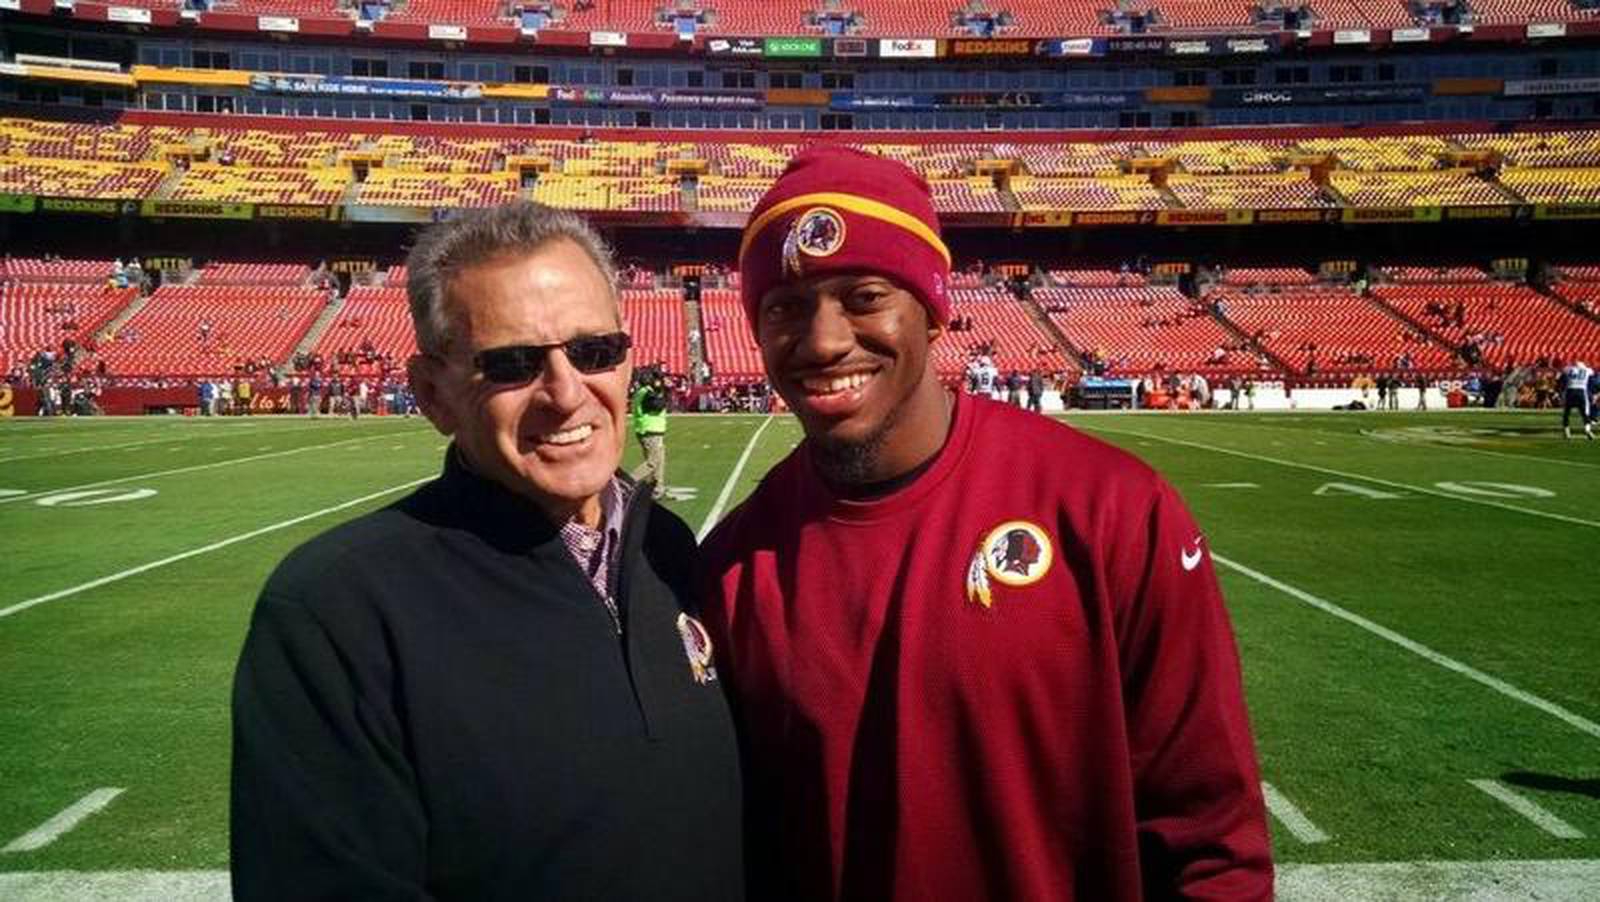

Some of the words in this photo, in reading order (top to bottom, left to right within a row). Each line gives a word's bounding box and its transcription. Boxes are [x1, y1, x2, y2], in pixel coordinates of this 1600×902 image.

[892, 41, 923, 52] FedEx
[954, 41, 1029, 54] REDSKINS
[294, 82, 316, 92] SAFE
[318, 83, 340, 93] RIDE
[341, 85, 368, 94] HOME
[43, 199, 117, 212] REDSKINS
[154, 203, 223, 215] REDSKINS
[259, 206, 326, 218] REDSKINS
[1258, 210, 1319, 222] REDSKINS
[1352, 209, 1413, 221] REDSKINS
[1449, 207, 1512, 218] REDSKINS
[1077, 213, 1137, 225] REDSKINS
[1166, 213, 1227, 225] REDSKINS
